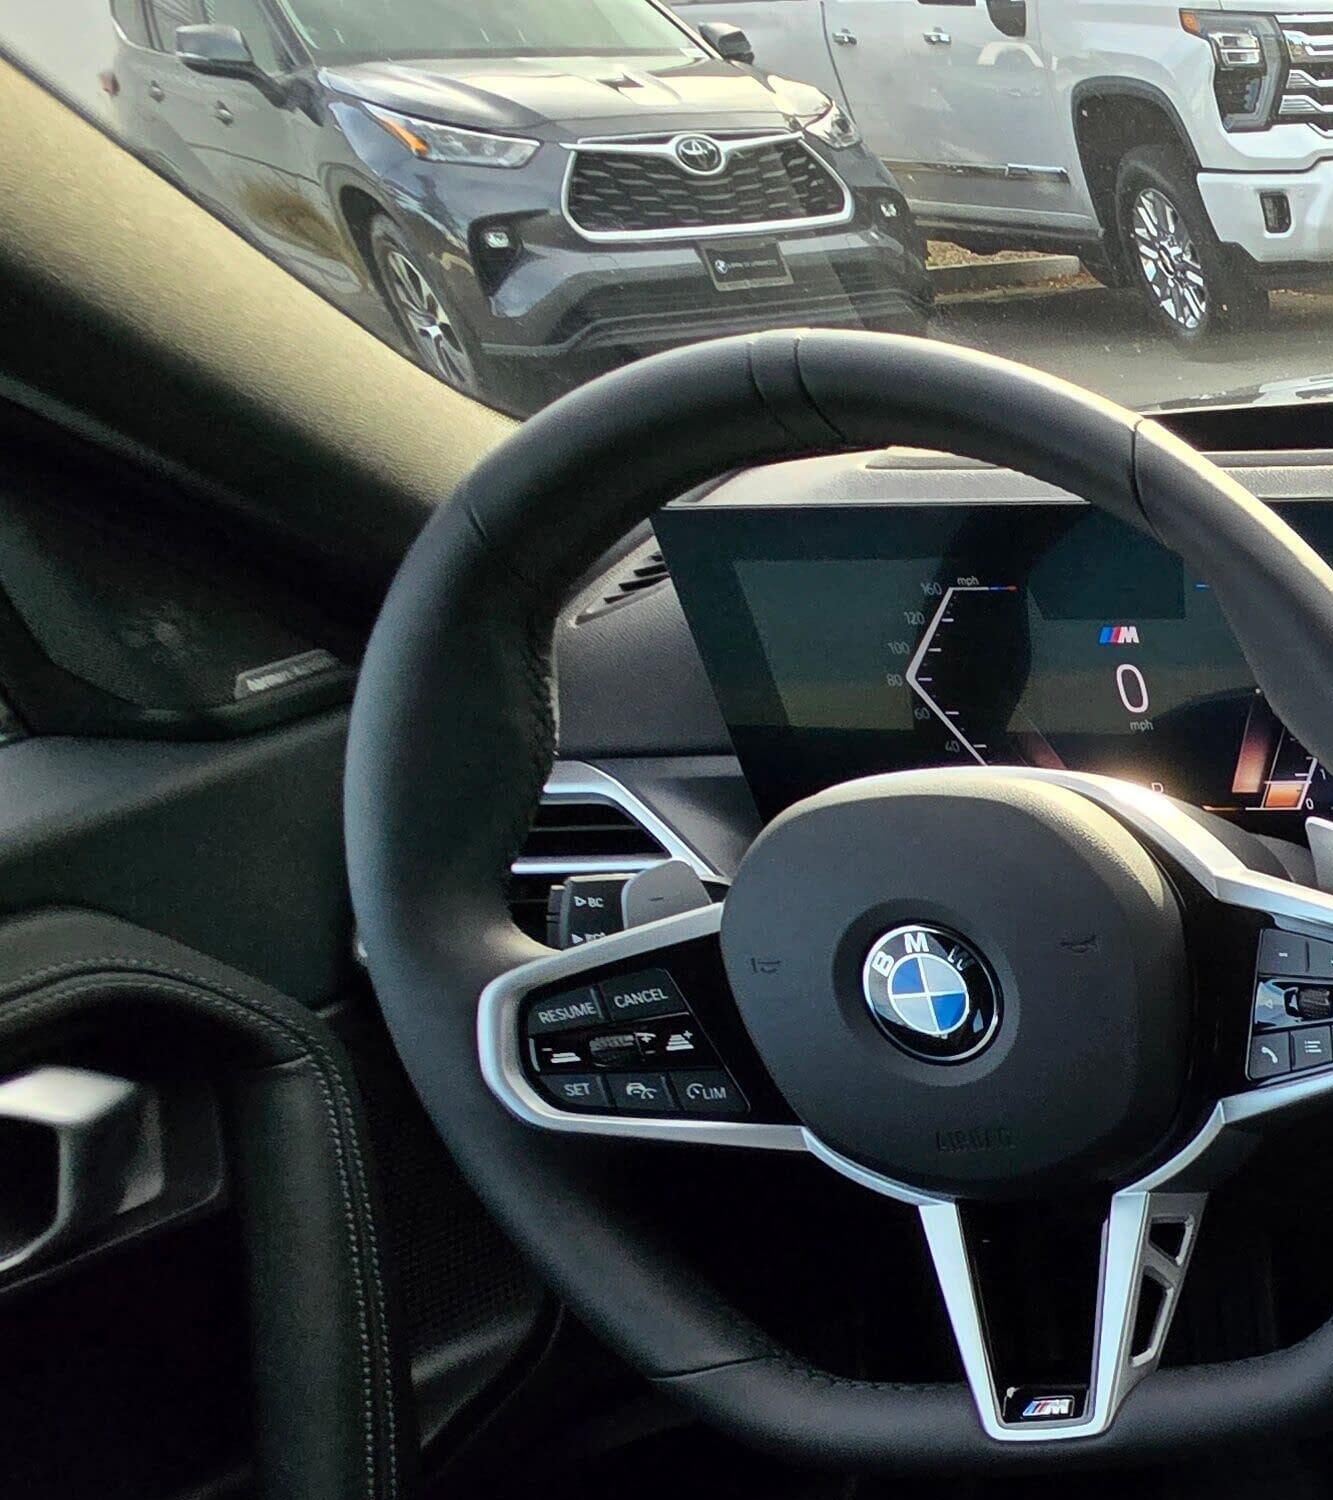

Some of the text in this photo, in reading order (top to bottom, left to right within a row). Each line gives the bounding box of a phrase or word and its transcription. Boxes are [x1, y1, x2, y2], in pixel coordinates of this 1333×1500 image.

[903, 611, 926, 625] 120
[1115, 663, 1150, 713] 0
[1129, 719, 1154, 732] mph
[613, 987, 669, 1009] CANCEL
[537, 1001, 597, 1024] RESUME
[563, 1082, 591, 1097] SET
[701, 1087, 727, 1100] LIM
